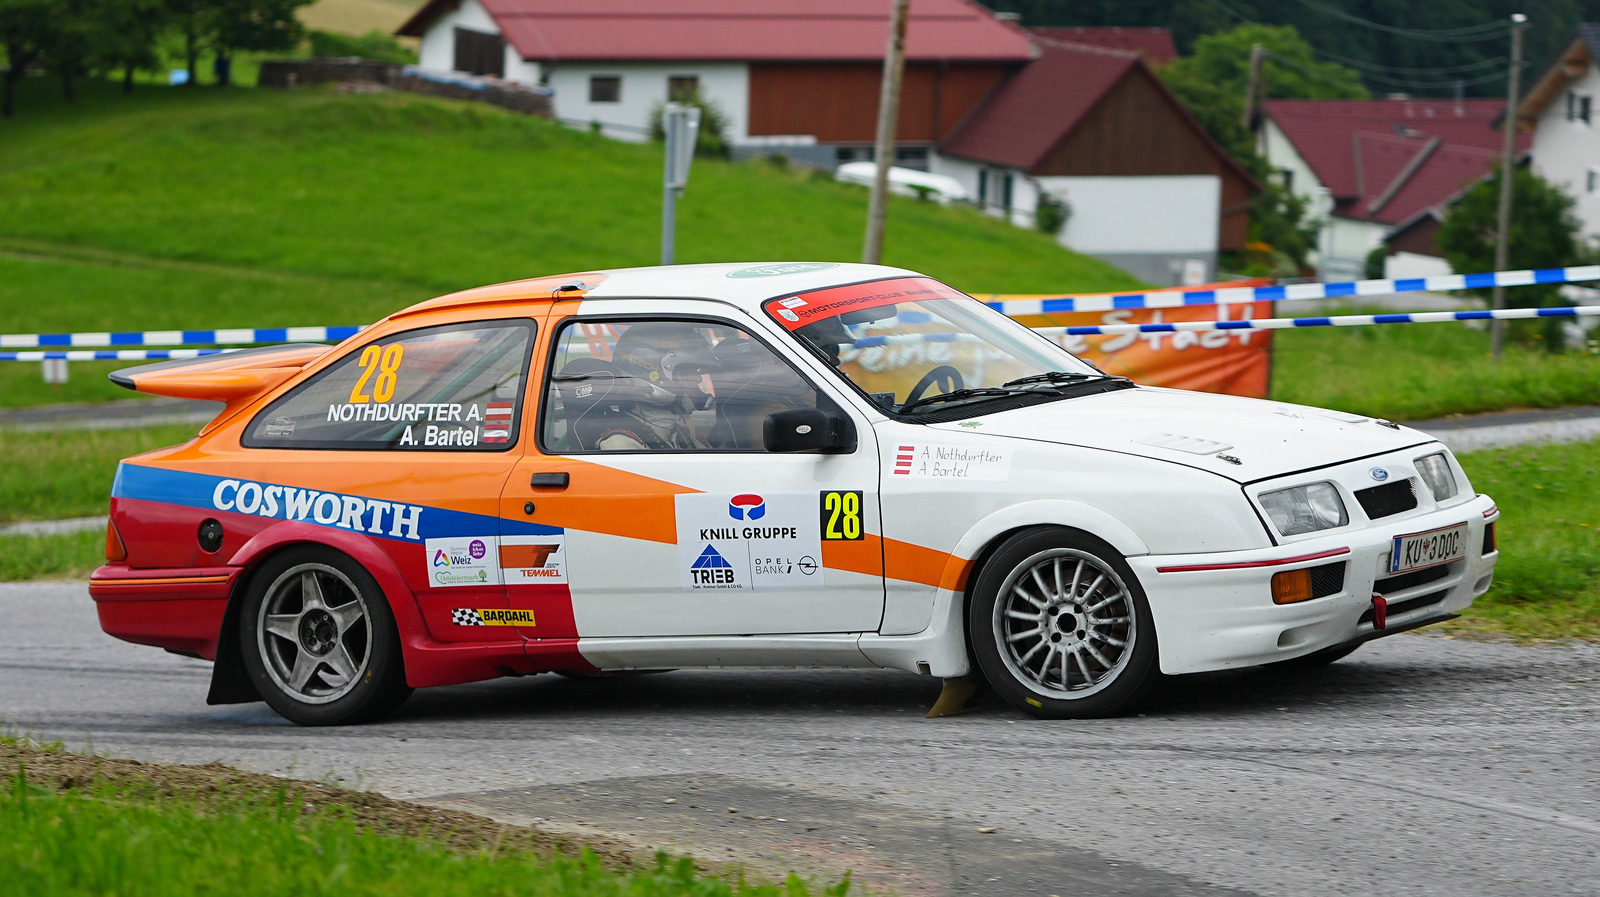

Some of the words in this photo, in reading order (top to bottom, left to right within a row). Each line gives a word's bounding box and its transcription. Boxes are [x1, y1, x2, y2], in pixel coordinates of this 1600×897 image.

[348, 344, 404, 404] 28
[326, 403, 463, 422] NOTHDURFTER
[464, 403, 484, 422] A.
[399, 425, 419, 447] A.
[424, 425, 479, 447] Bartel
[936, 446, 1003, 465] Nothdurfter
[212, 478, 424, 541] COSWORTH
[824, 491, 861, 540] 28
[699, 528, 739, 541] KNILL
[742, 527, 797, 540] GRUPPE
[450, 555, 472, 565] Weiz
[1405, 538, 1423, 566] KU
[755, 557, 793, 565] OPEL
[520, 569, 562, 578] TEMMEL
[690, 569, 735, 584] TRIEB
[755, 565, 785, 575] BANK
[483, 610, 534, 625] BARDAHL
